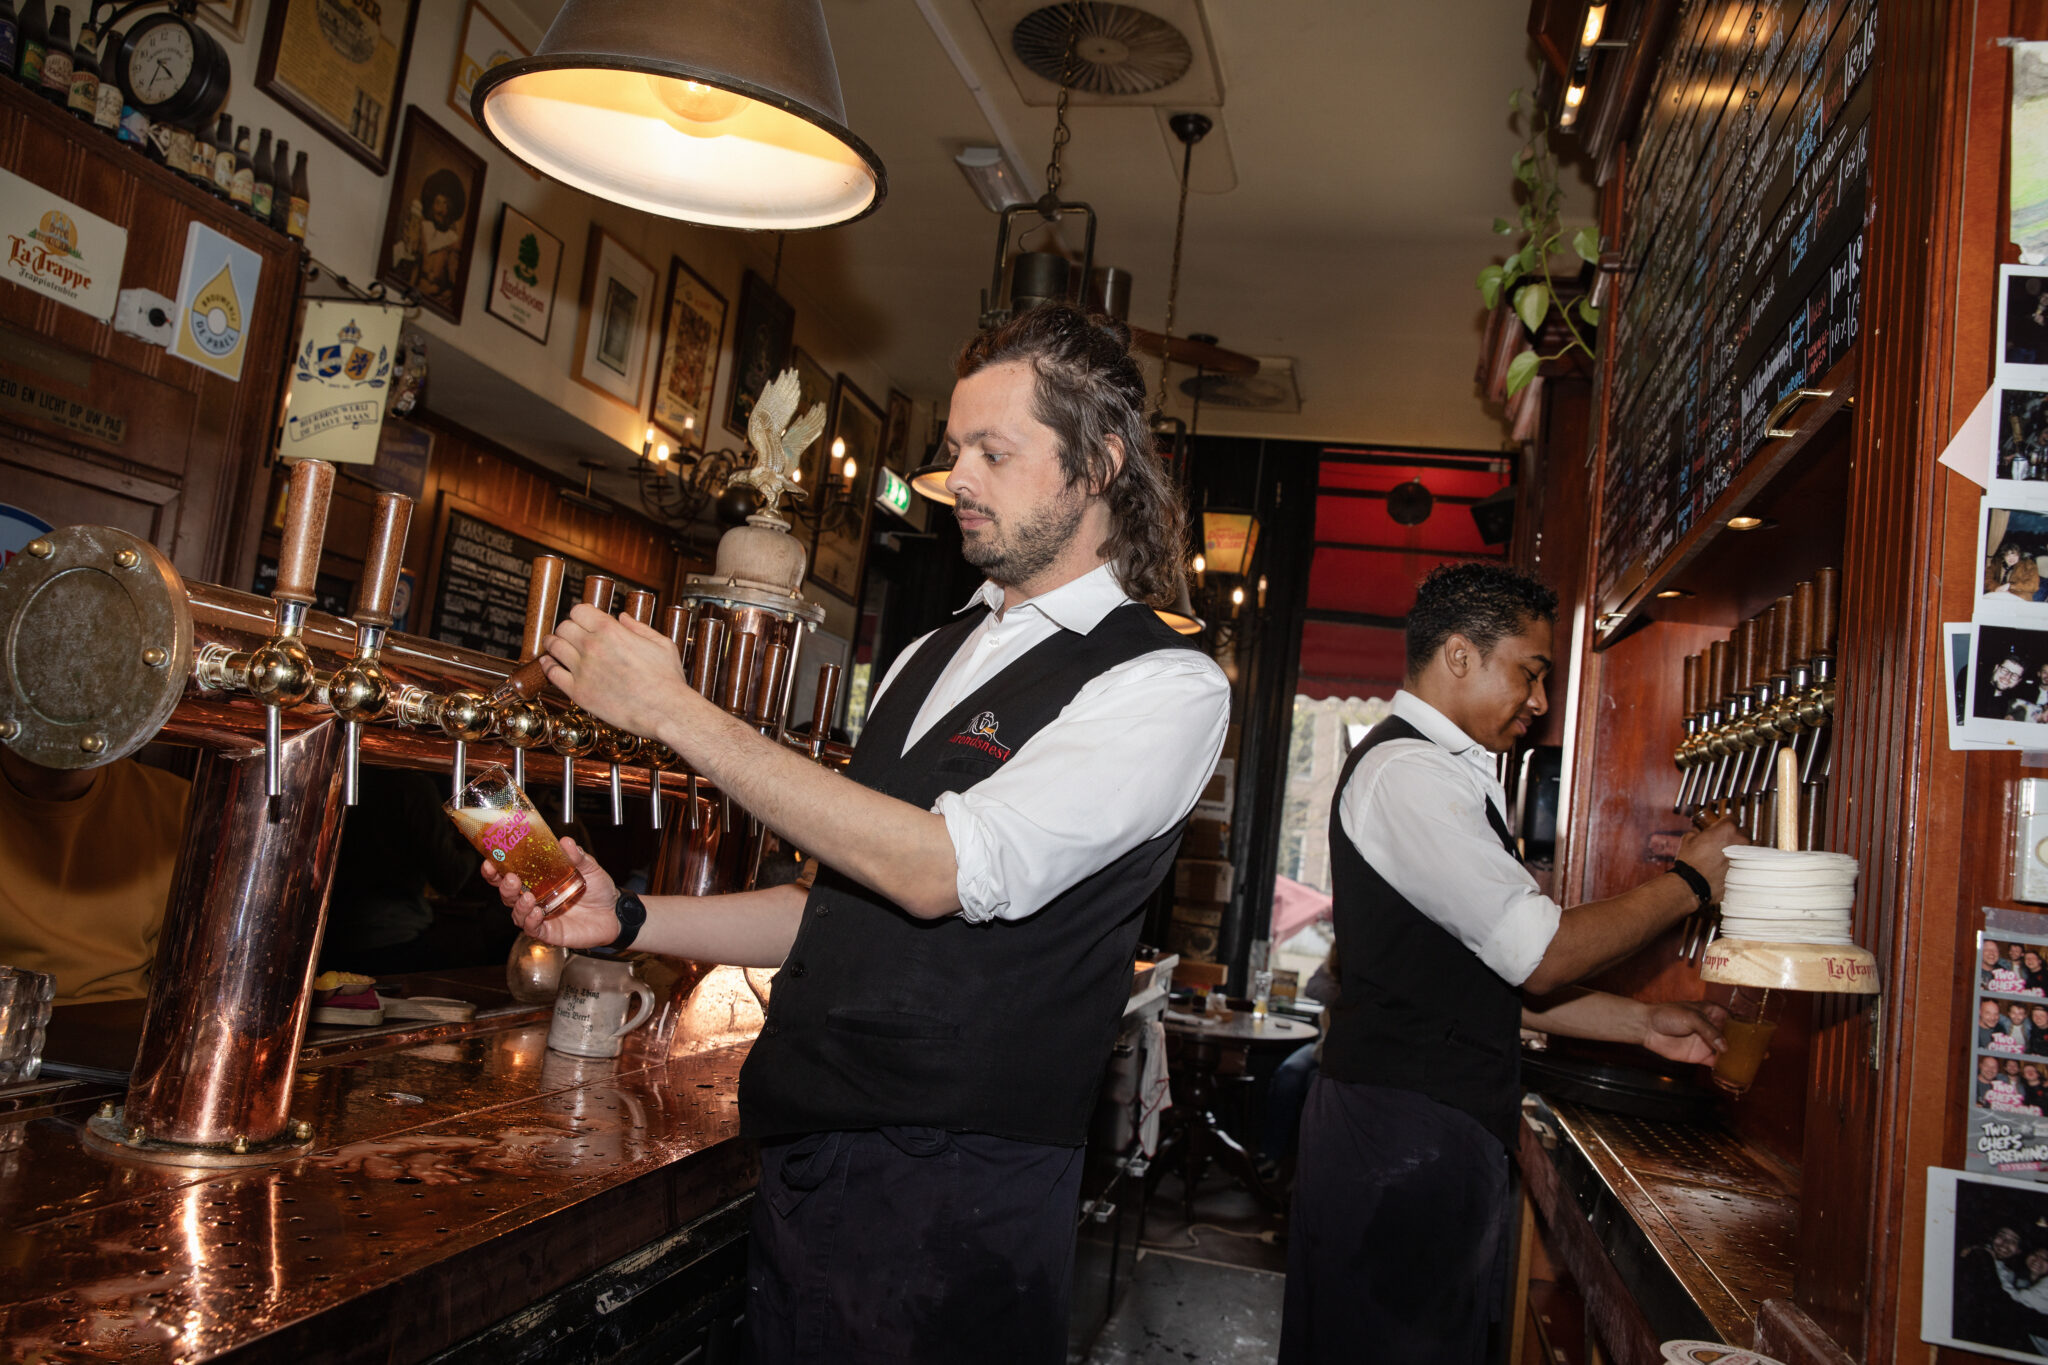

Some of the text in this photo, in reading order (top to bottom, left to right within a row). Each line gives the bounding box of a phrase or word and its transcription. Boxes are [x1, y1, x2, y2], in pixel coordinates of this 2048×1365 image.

[1776, 200, 1797, 244] CASK
[1799, 171, 1810, 213] &
[8, 234, 32, 268] La
[32, 246, 92, 291] Trappe
[500, 269, 545, 313] Lindeboom
[206, 334, 235, 350] PRAEL
[1831, 317, 1847, 348] 10%
[21, 386, 35, 404] EN
[39, 392, 67, 414] LICHT
[498, 821, 531, 853] Kater
[1704, 956, 1730, 970] rappe
[1821, 957, 1876, 982] La Trapp
[1992, 968, 2016, 980] TWO
[1988, 979, 2026, 993] CHEFS
[1992, 1032, 2016, 1045] TWO
[1981, 1122, 2011, 1136] TWO
[1978, 1133, 2023, 1152] CHEFS
[1988, 1144, 2048, 1166] BREWING
